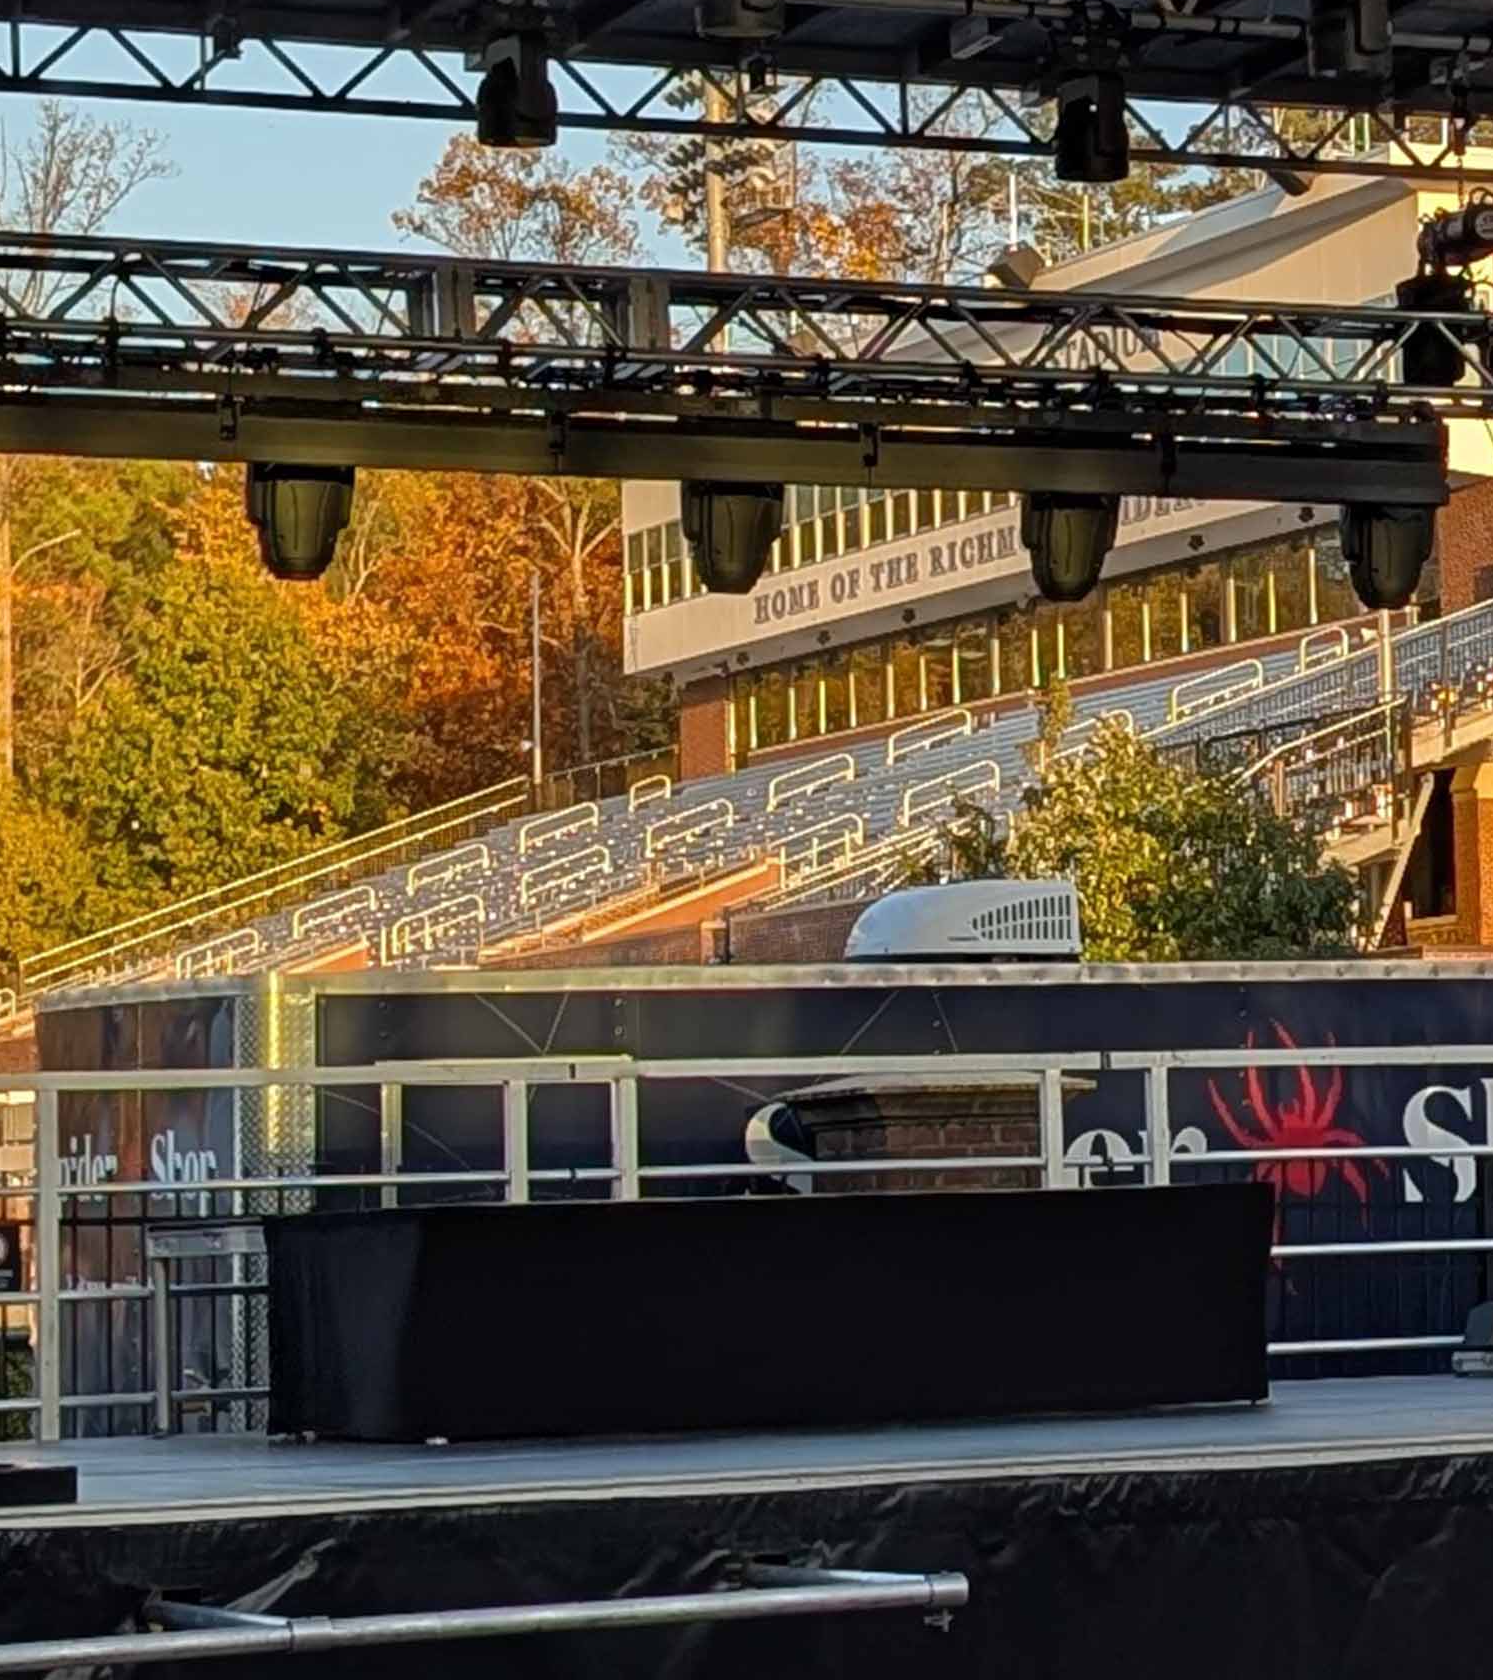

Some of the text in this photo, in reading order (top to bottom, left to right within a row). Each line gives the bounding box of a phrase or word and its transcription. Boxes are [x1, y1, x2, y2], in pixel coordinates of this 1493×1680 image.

[754, 579, 821, 624] HOME
[830, 570, 860, 604] OF
[870, 552, 919, 592] THE
[929, 526, 1018, 576] RICHM
[57, 1133, 119, 1219] pider
